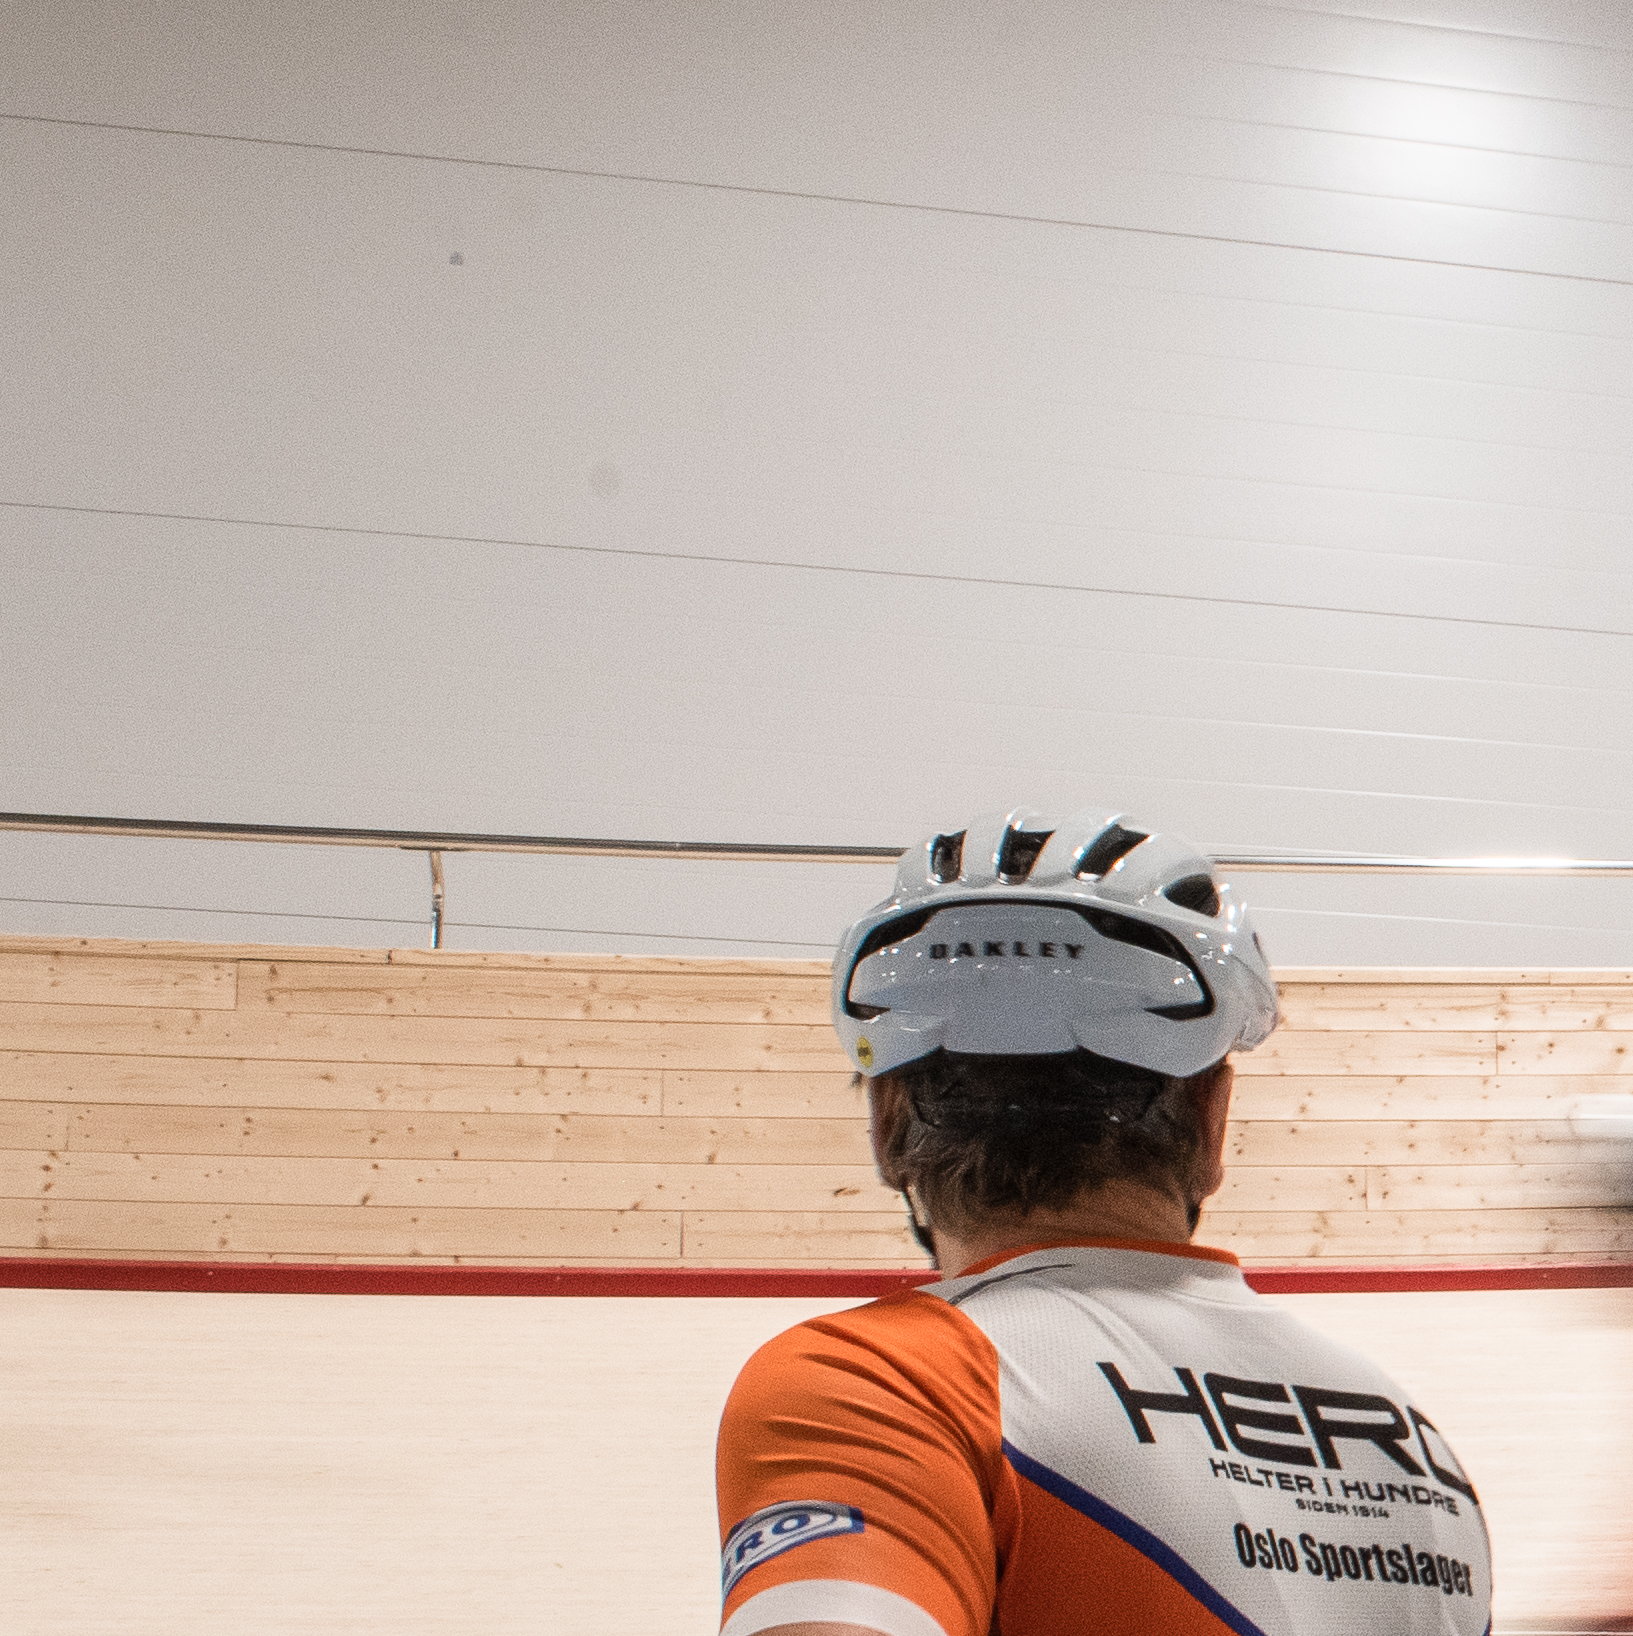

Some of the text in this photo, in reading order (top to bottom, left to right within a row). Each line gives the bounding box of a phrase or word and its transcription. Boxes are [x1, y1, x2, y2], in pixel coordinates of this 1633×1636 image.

[928, 940, 1085, 961] OAKLEY
[1208, 1457, 1317, 1496] HELTER
[1340, 1479, 1460, 1517] HUNDRE
[1295, 1497, 1350, 1516] SIDEN
[1233, 1522, 1474, 1597] Oslo Sportslager
